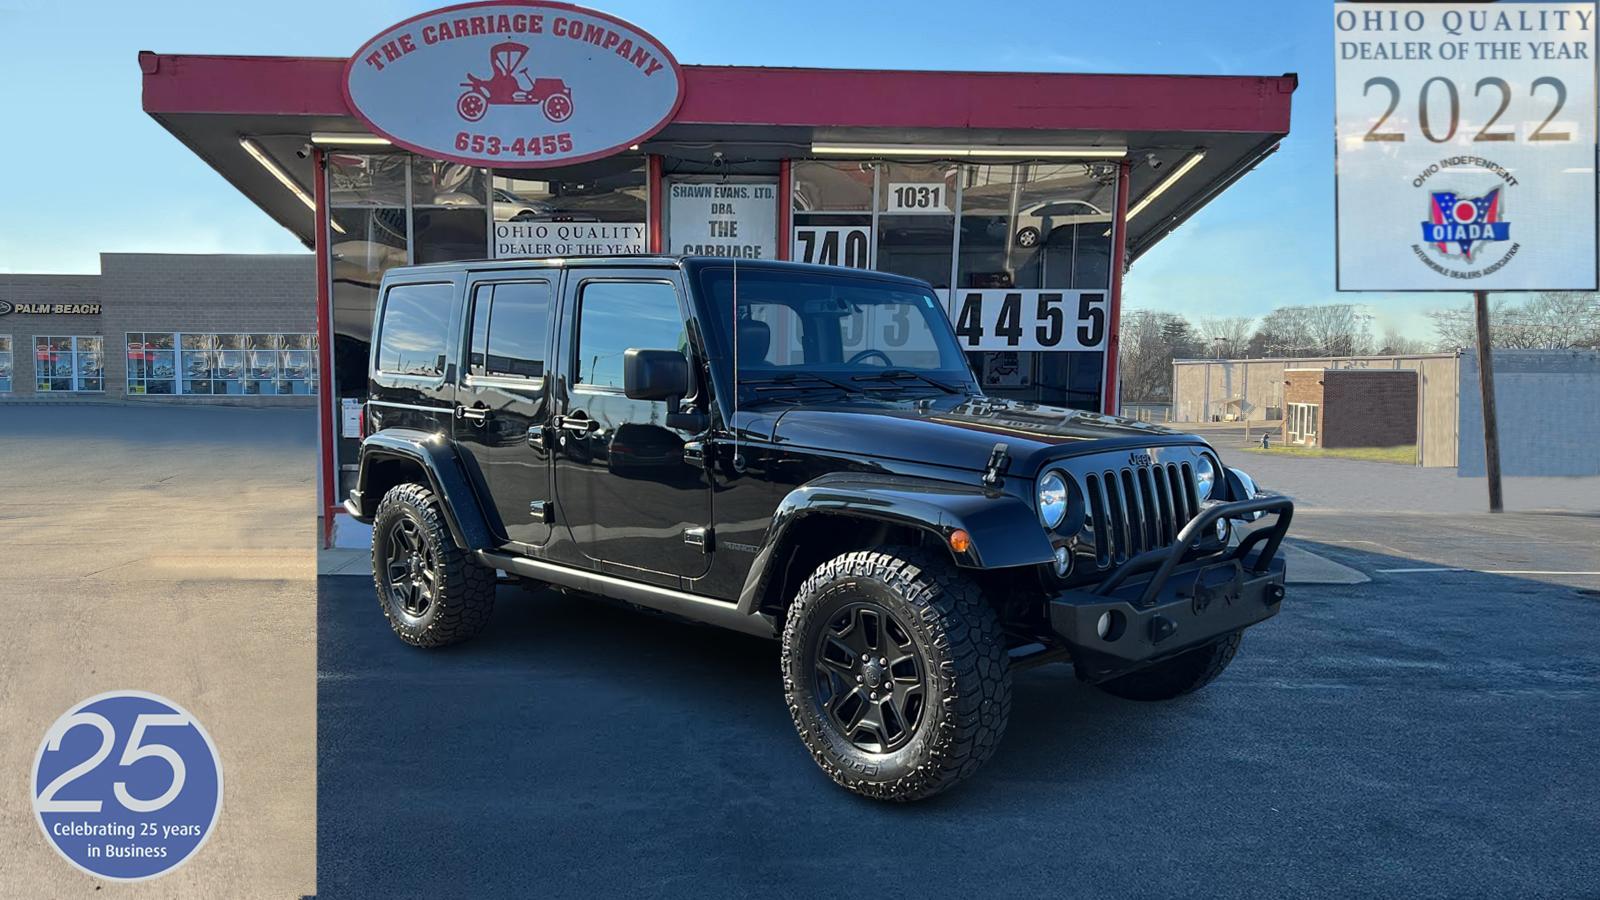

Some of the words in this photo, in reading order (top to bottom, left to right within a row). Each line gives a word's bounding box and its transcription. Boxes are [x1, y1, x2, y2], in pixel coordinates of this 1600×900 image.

[1336, 10, 1425, 31] OHIO
[1442, 10, 1592, 35] QUALITY
[366, 33, 416, 71] THE
[422, 14, 544, 45] CARRIAGE
[553, 17, 664, 77] COMPANY
[1340, 42, 1433, 60] DEALER
[1439, 42, 1469, 60] OF
[1475, 42, 1522, 60] THE
[1528, 41, 1589, 60] YEAR
[1363, 76, 1570, 143] 2022
[455, 132, 573, 156] 653-4455
[1412, 164, 1439, 188] OHIO
[1440, 156, 1519, 187] INDEPENDENT
[673, 186, 711, 198] SHAWN
[754, 187, 774, 199] LTD.
[894, 186, 940, 208] 1031
[711, 203, 735, 214] DBA.
[497, 226, 548, 238] OHIO
[557, 226, 643, 240] QUALITY
[709, 220, 737, 237] THE
[1433, 225, 1495, 240] OIADA
[500, 244, 552, 254] DEALER
[555, 244, 573, 254] OF
[579, 244, 602, 254] THE
[607, 244, 641, 254] YEAR
[683, 244, 762, 259] CARRIAGE
[797, 230, 868, 269] 740
[15, 304, 50, 314] PALM
[55, 304, 100, 314] BEACH
[1128, 453, 1151, 466] Jeep
